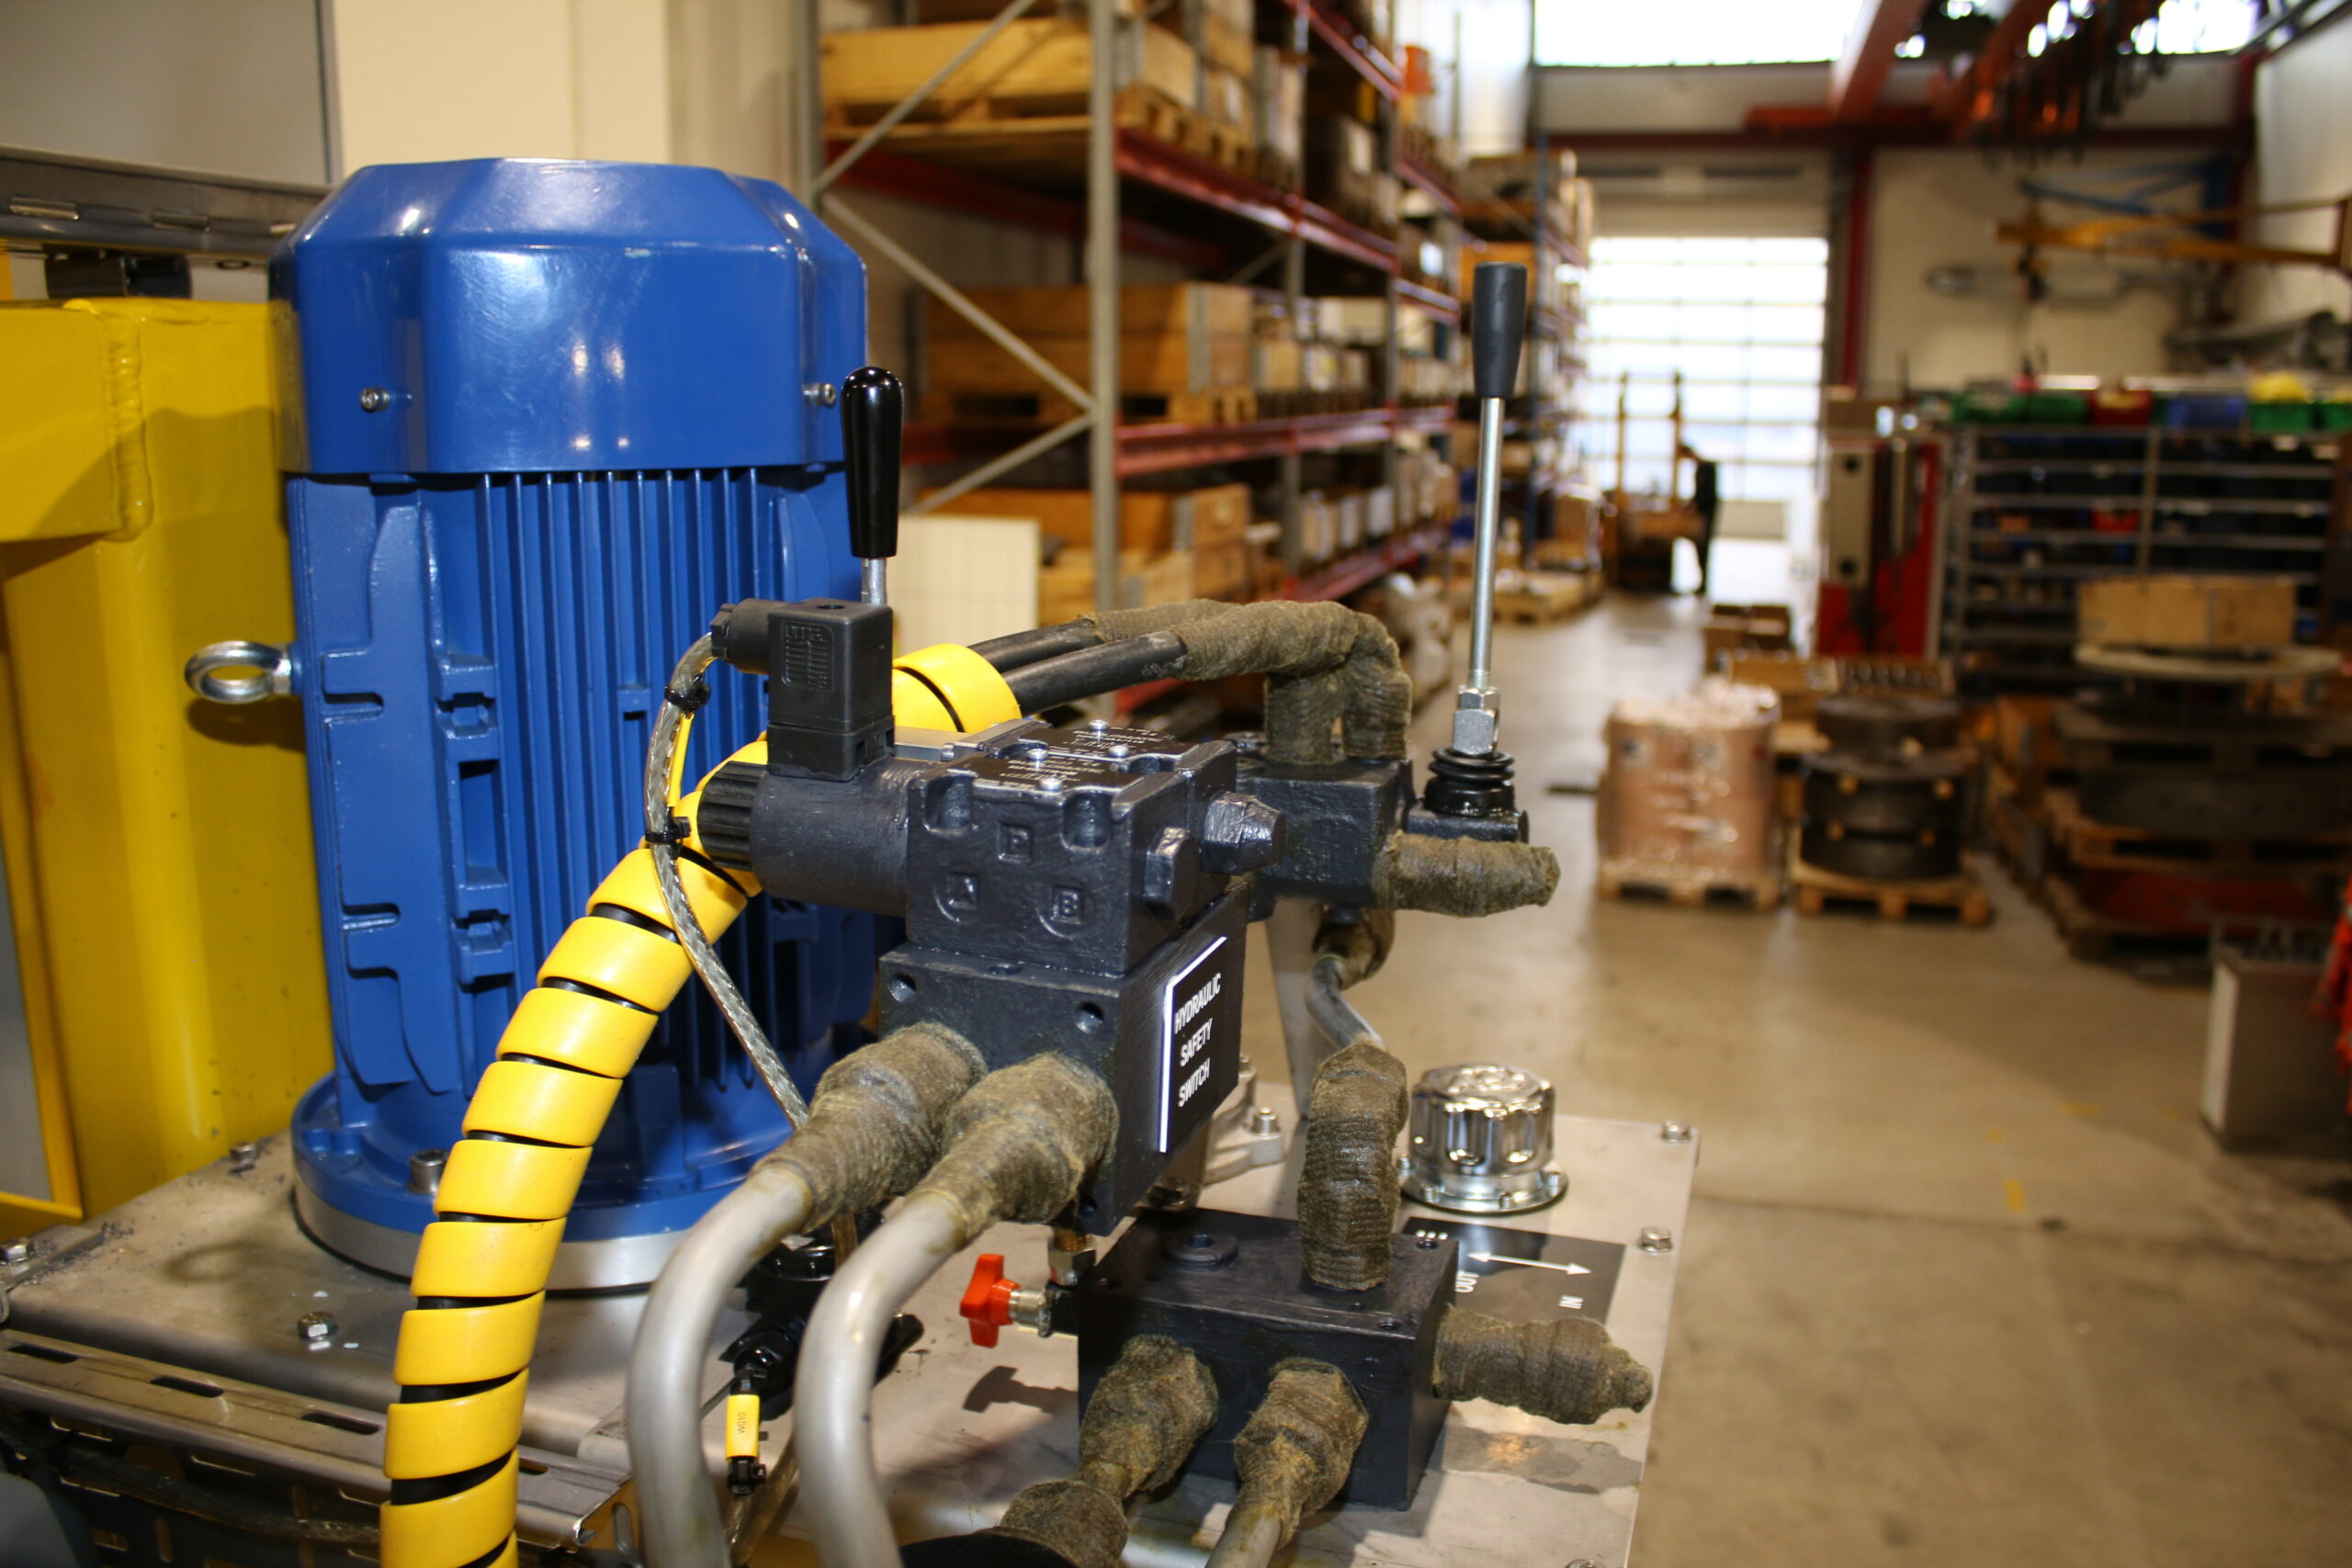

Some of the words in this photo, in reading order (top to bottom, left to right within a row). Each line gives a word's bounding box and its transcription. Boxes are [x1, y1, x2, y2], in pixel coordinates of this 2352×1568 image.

[1173, 972, 1222, 1034] HYDRAULIC
[1180, 1018, 1213, 1067] SAFETY
[1177, 1057, 1210, 1108] SWITCH
[1454, 1270, 1479, 1293] OUT
[1558, 1294, 1584, 1310] IN
